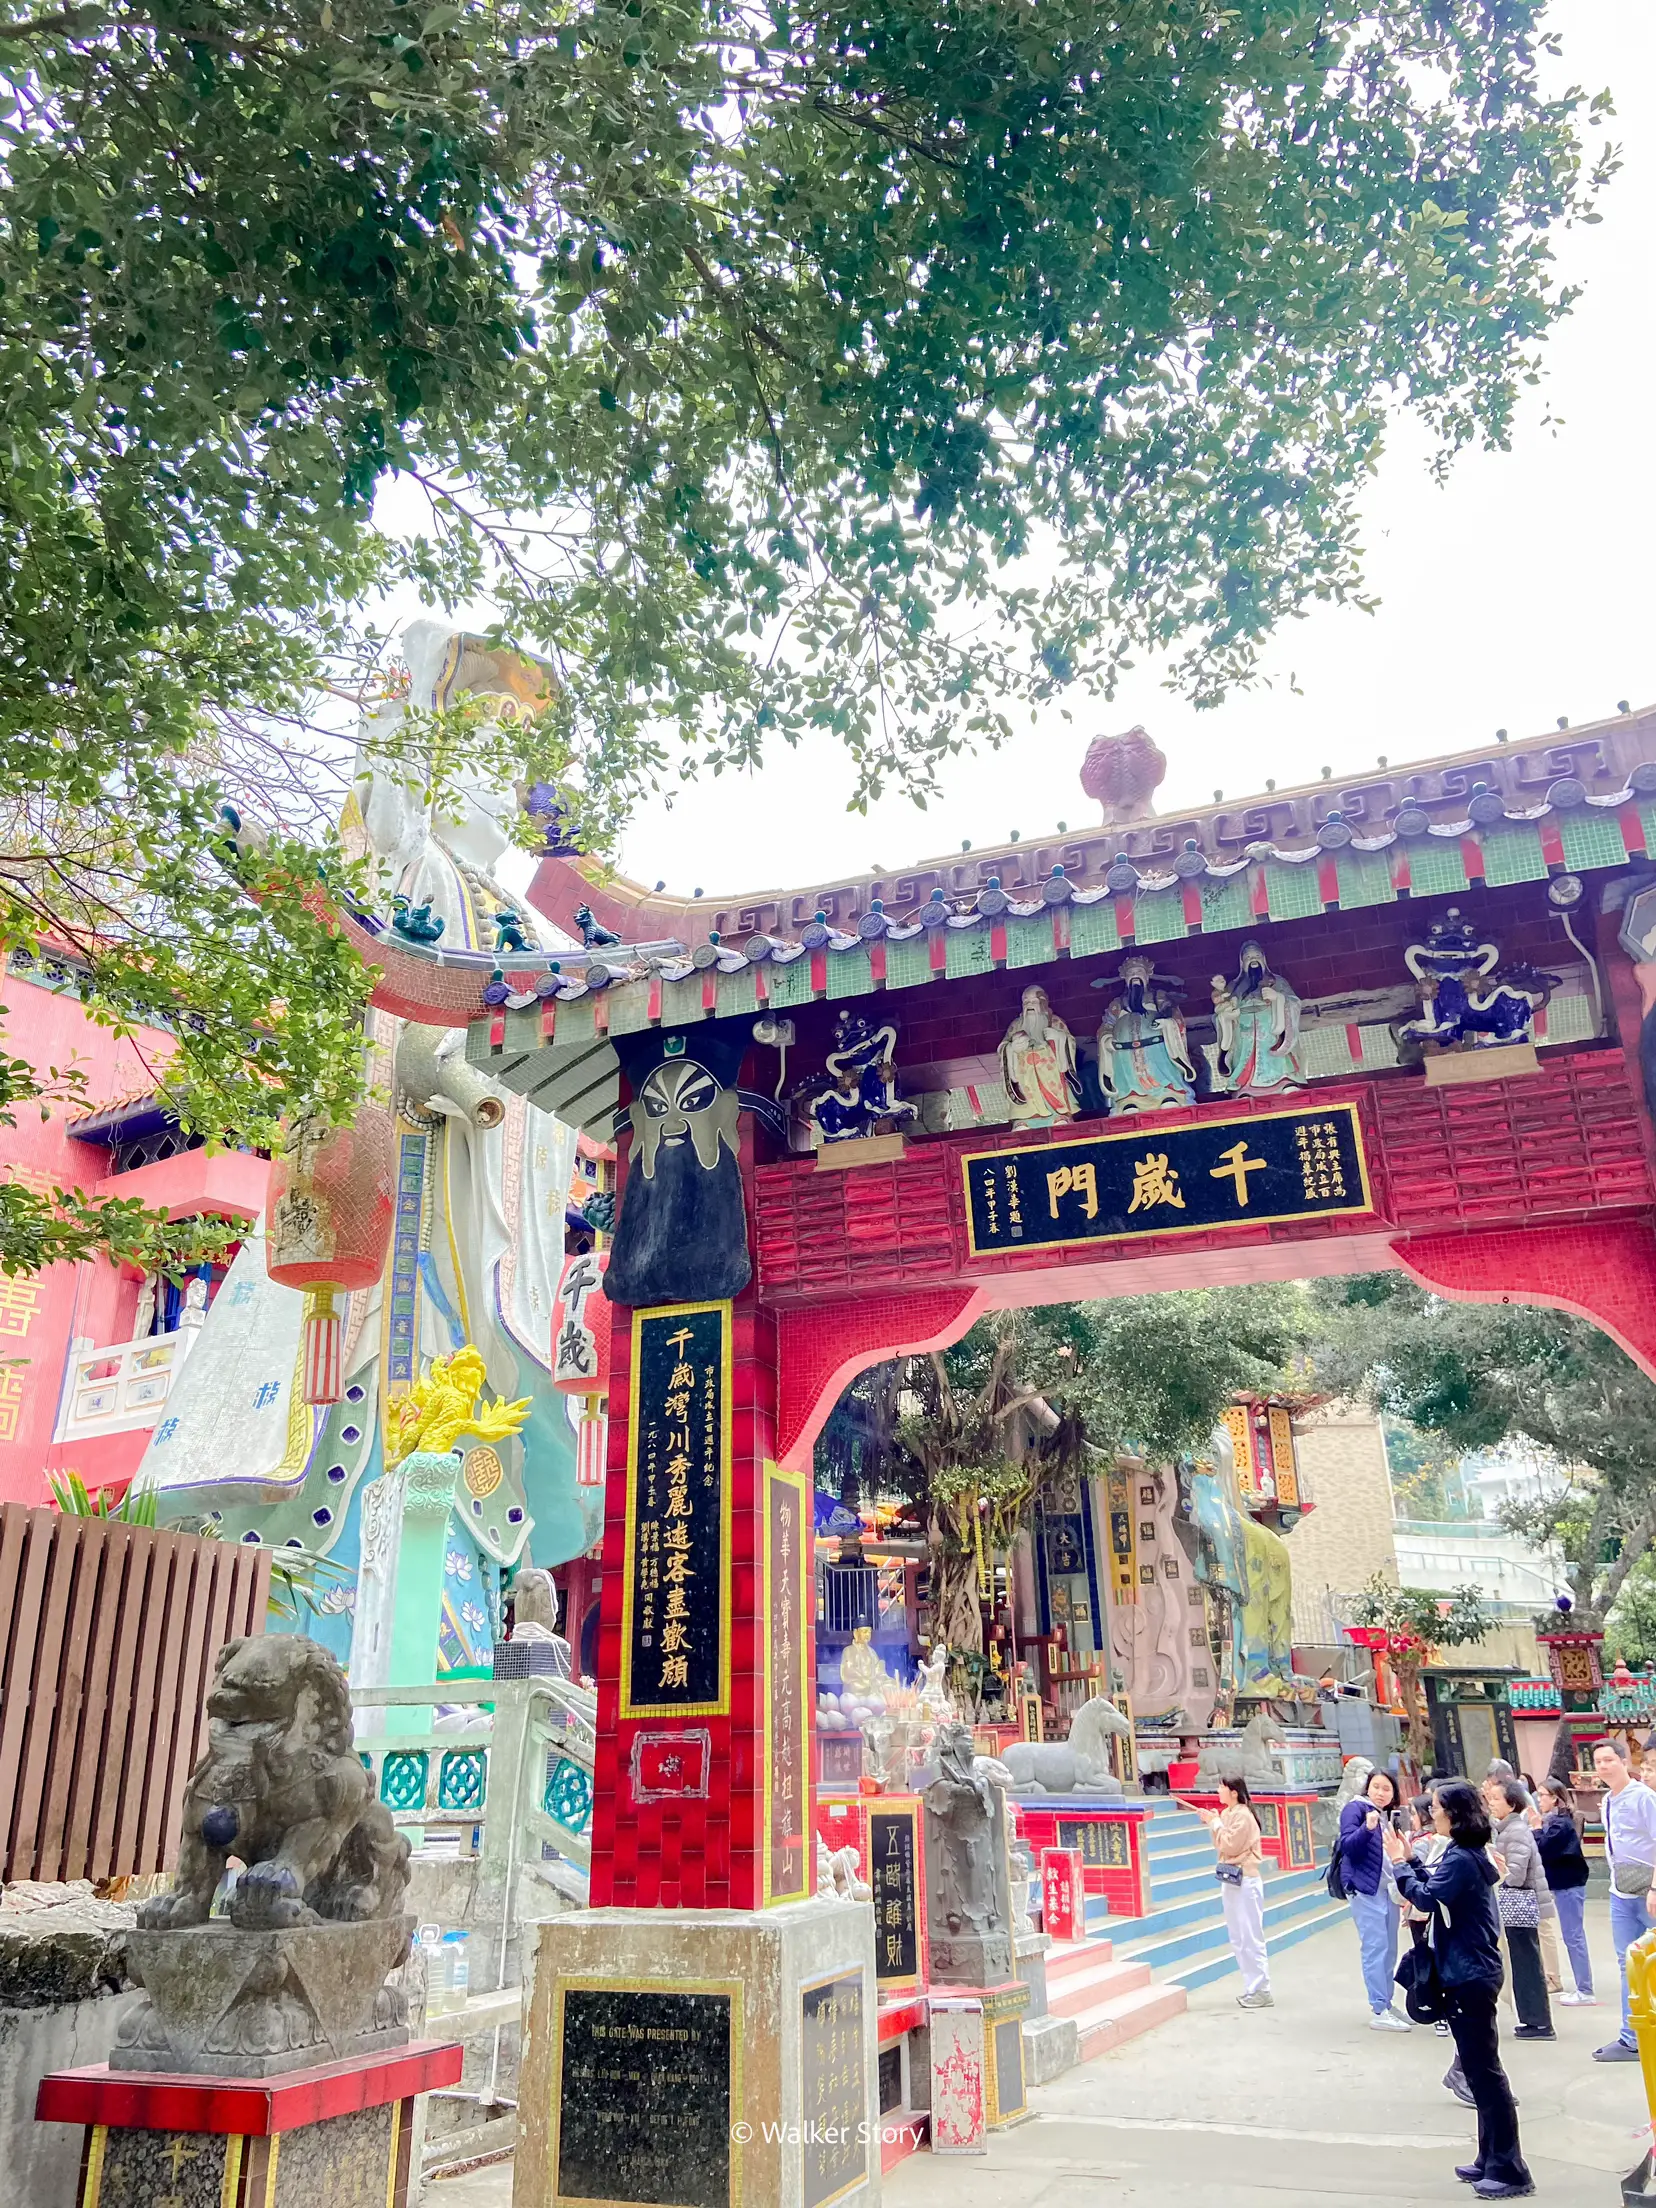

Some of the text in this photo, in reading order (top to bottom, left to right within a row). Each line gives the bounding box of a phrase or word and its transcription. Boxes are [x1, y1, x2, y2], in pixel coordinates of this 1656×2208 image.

[983, 1168, 1001, 1235] 八四年甲子春
[557, 1257, 597, 1375] 千歲
[703, 1364, 716, 1487] 市政局成立百週年紀念
[646, 1421, 659, 1508] 一九八四年甲子春
[1059, 1531, 1071, 1568] 大吉
[608, 2026, 627, 2039] GATE
[629, 2027, 645, 2039] WAS
[647, 2028, 689, 2041] PRESENTED
